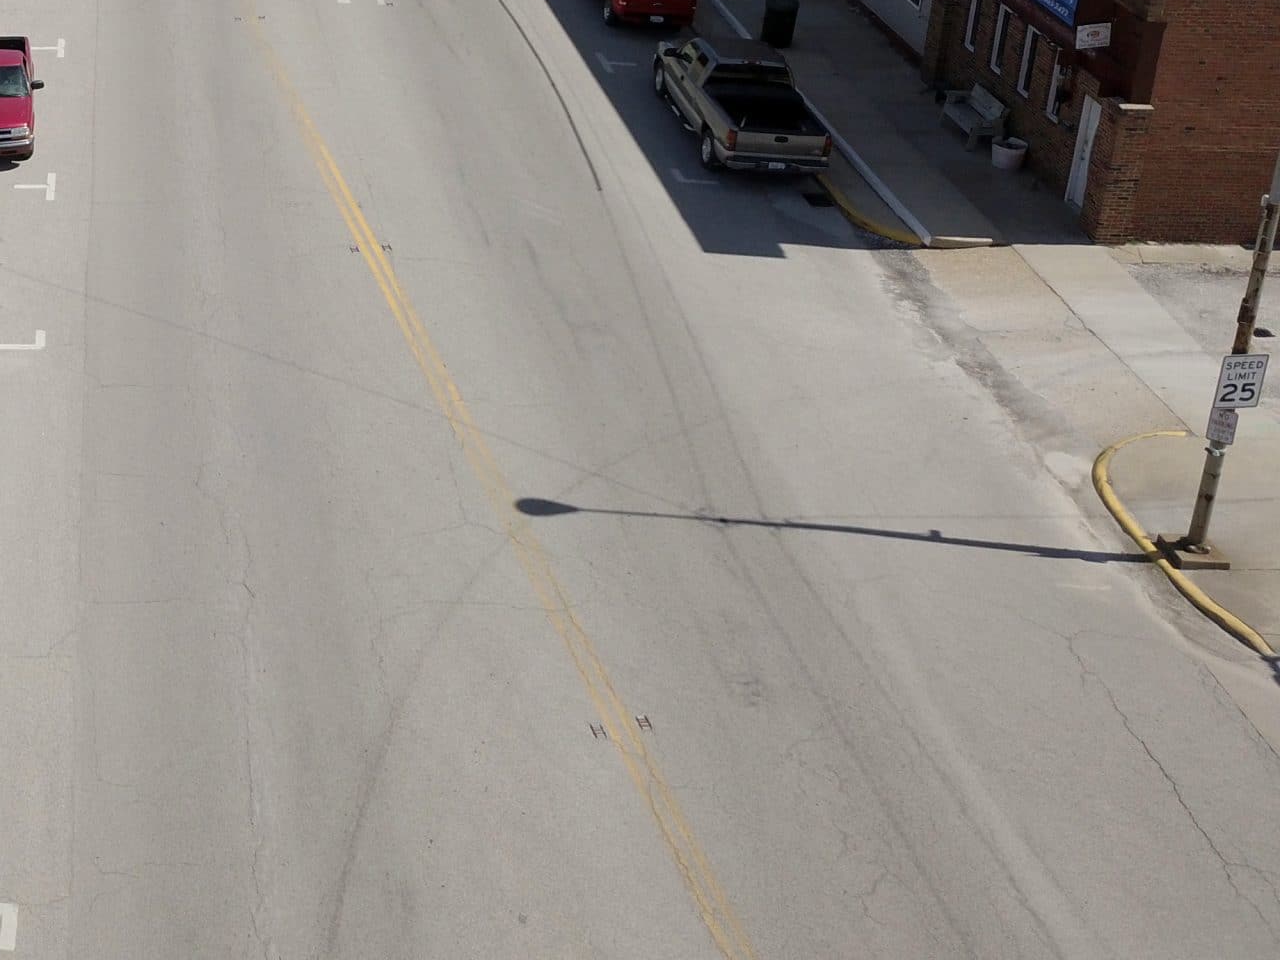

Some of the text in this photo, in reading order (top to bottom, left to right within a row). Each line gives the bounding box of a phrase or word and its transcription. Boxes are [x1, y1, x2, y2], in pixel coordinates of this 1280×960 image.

[1225, 361, 1264, 370] SPEED
[1227, 372, 1257, 381] LIMIT
[1219, 382, 1256, 402] 25
